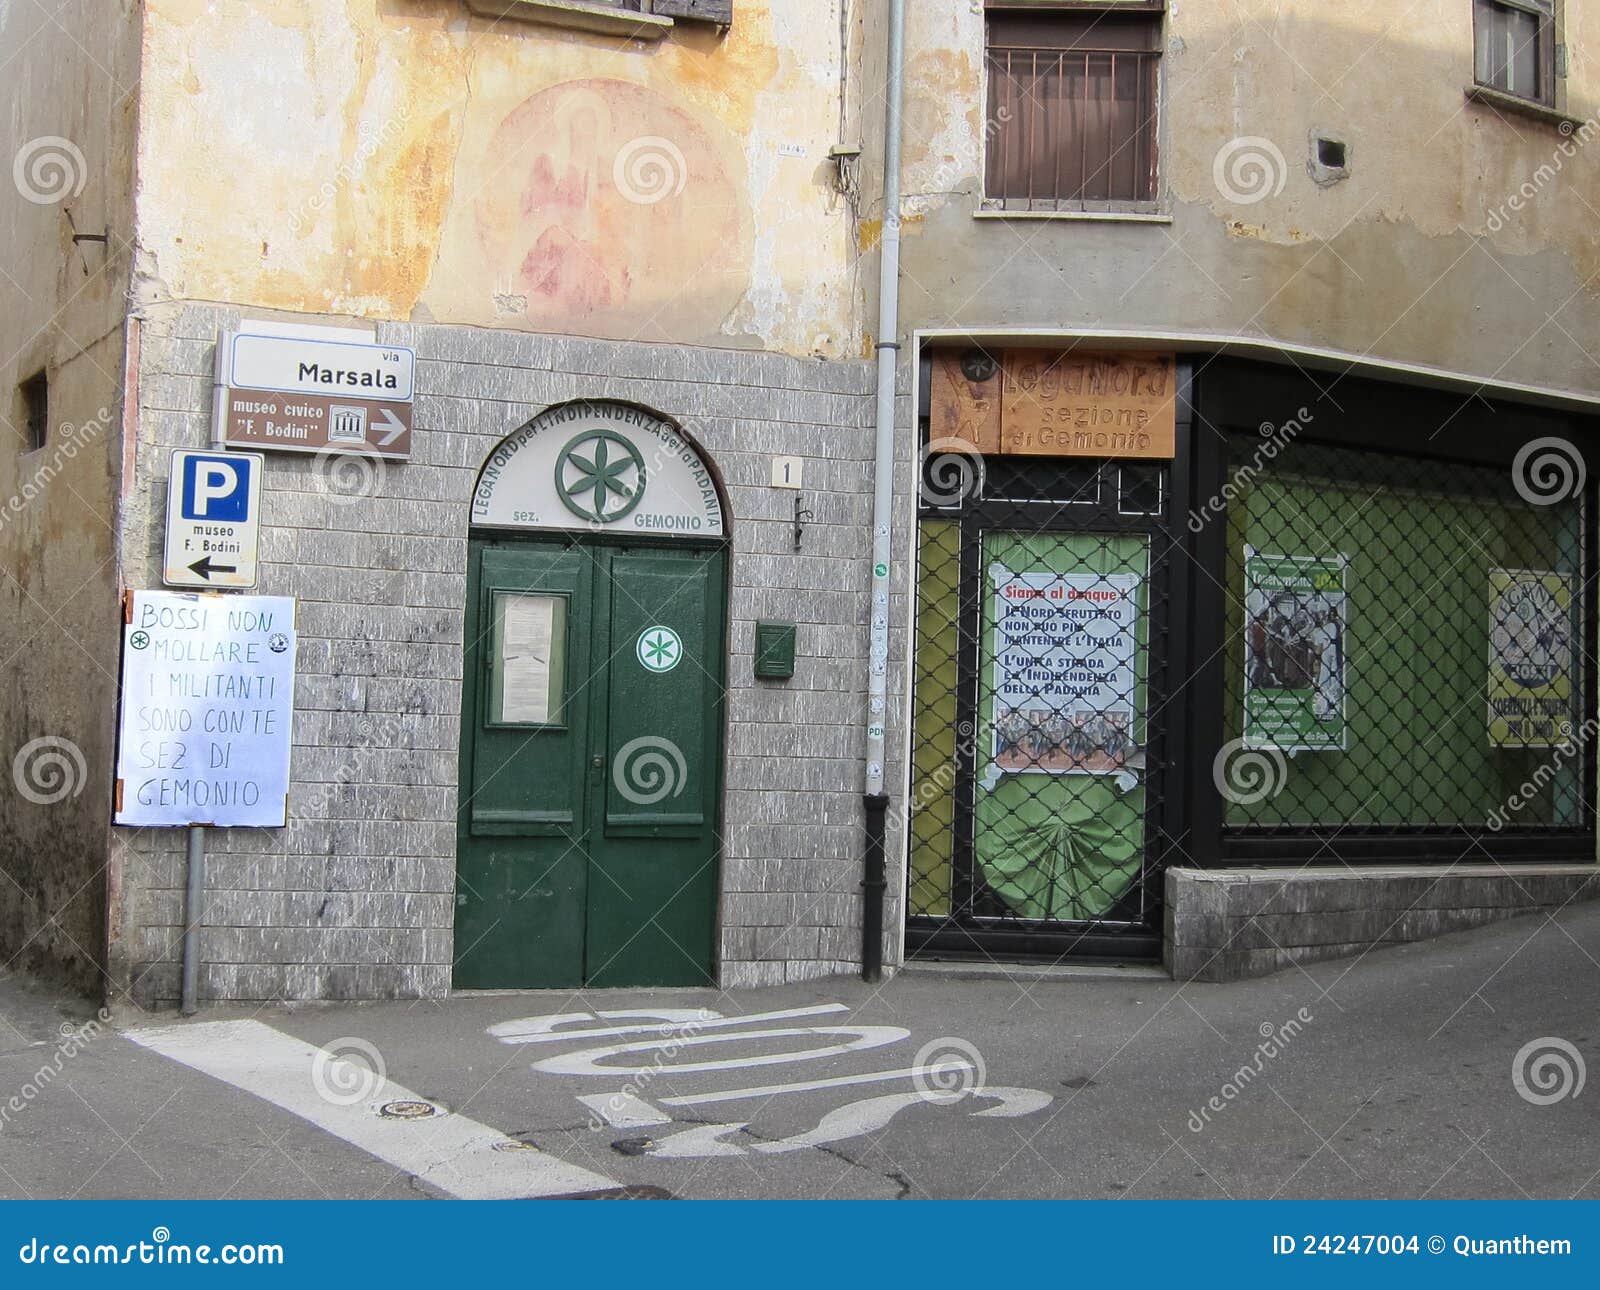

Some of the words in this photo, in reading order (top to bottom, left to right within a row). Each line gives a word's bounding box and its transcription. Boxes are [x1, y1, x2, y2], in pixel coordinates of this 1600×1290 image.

[382, 351, 400, 362] via
[299, 362, 397, 389] Marsala
[233, 400, 277, 415] museo
[284, 402, 323, 419] civico
[1038, 427, 1151, 449] Gemonio
[783, 462, 791, 483] 1
[193, 461, 238, 516] P
[687, 459, 720, 528] PADANIA
[193, 525, 234, 536] museo
[513, 511, 540, 522] sez.
[634, 513, 701, 530] GEMONIO
[185, 539, 194, 551] F.
[203, 540, 240, 553] Bodini
[1050, 586, 1063, 599] al
[141, 603, 207, 630] BOSSI
[228, 611, 273, 633] NON
[154, 639, 260, 664] MOLLARE
[1004, 654, 1053, 667] L'UNIA
[1013, 668, 1118, 682] 'INDIENDENZA
[169, 674, 275, 700] MILITANTI
[137, 706, 192, 732] SONO
[204, 708, 244, 734] CON
[252, 709, 277, 735] TE
[140, 741, 187, 770] SEZ
[210, 743, 231, 769] DI
[137, 778, 260, 807] GEMONIO
[486, 1003, 1054, 1158] STOP
